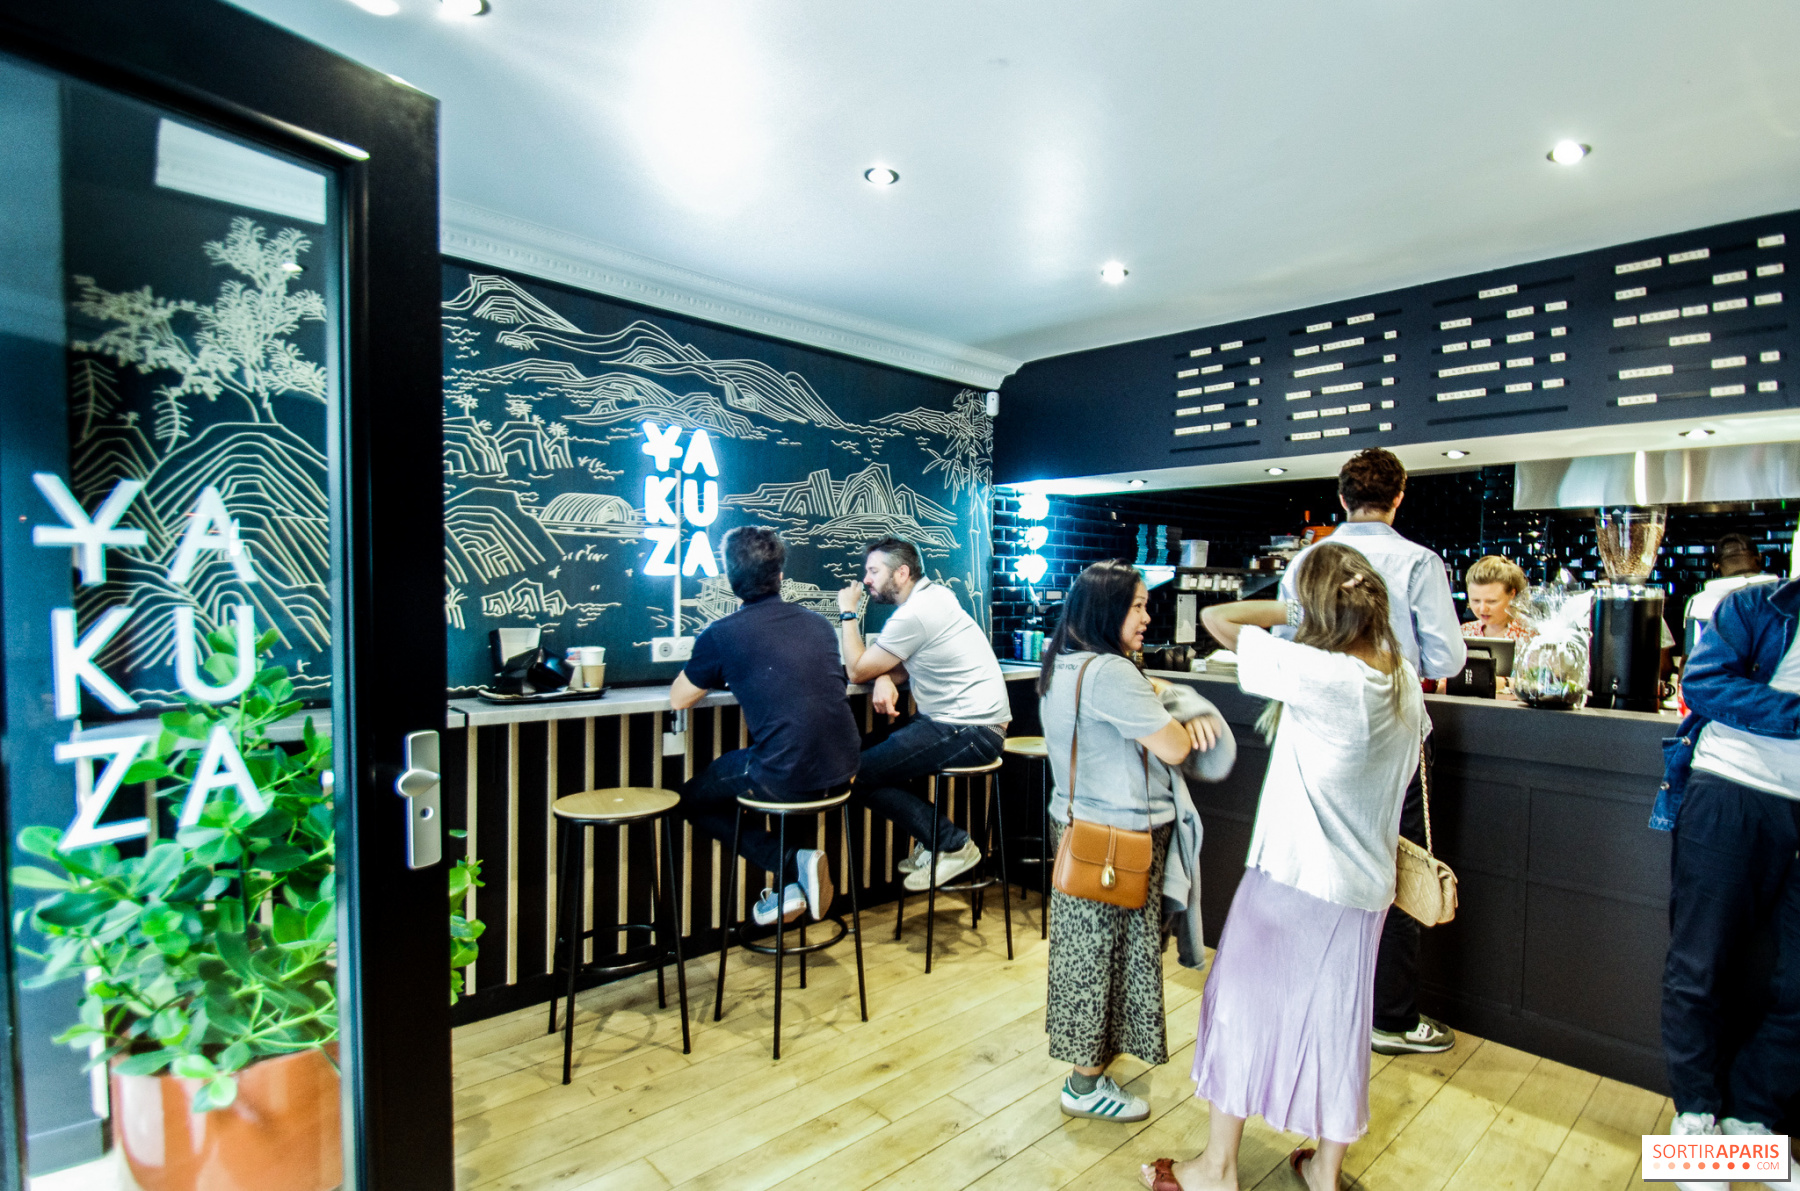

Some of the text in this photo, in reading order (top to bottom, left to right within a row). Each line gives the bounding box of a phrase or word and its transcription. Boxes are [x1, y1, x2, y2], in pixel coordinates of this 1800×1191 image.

[1617, 250, 1708, 273] MATCHA LATTE
[1480, 286, 1516, 297] DRINKS
[1349, 314, 1373, 324] SANDO
[1442, 319, 1470, 328] WATER
[1444, 343, 1466, 352] COLA
[1440, 363, 1498, 376] GINGERELLA
[1619, 366, 1672, 378] SAPPORO
[644, 475, 719, 527] KU
[643, 526, 719, 577] ZA
[51, 605, 256, 719] KU
[54, 726, 267, 852] ZA
